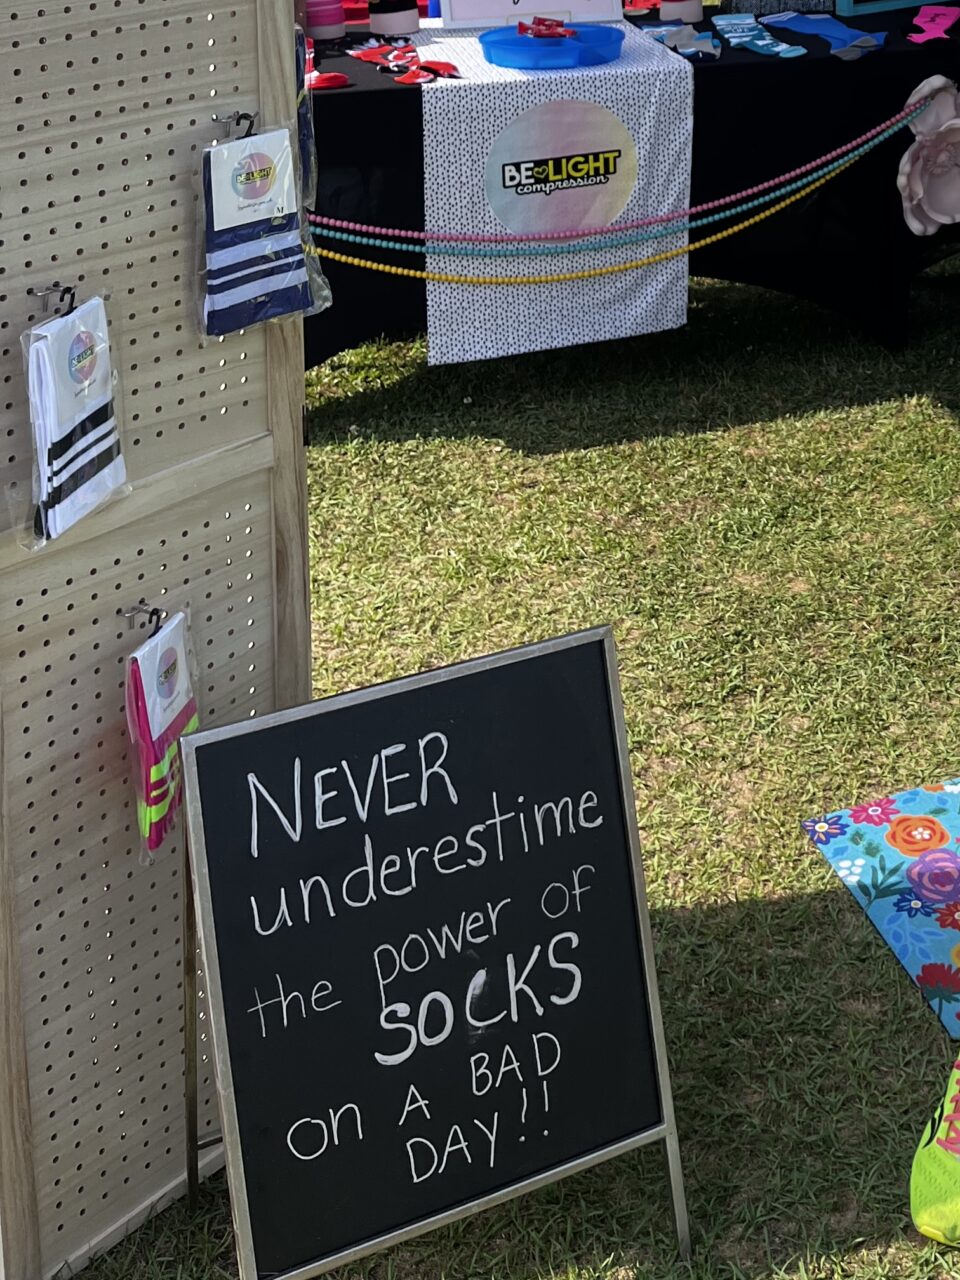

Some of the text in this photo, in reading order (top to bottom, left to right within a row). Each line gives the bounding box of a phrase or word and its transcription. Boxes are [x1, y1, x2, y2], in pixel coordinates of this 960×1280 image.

[504, 152, 619, 187] BE LIGHT
[516, 174, 608, 194] compression
[248, 731, 459, 857] NEVER
[250, 790, 604, 935] underestime
[247, 864, 596, 1037] the power of
[375, 931, 582, 1065] SOCKS
[287, 1032, 561, 1159] on A BAD
[406, 1080, 552, 1183] DAY!!
